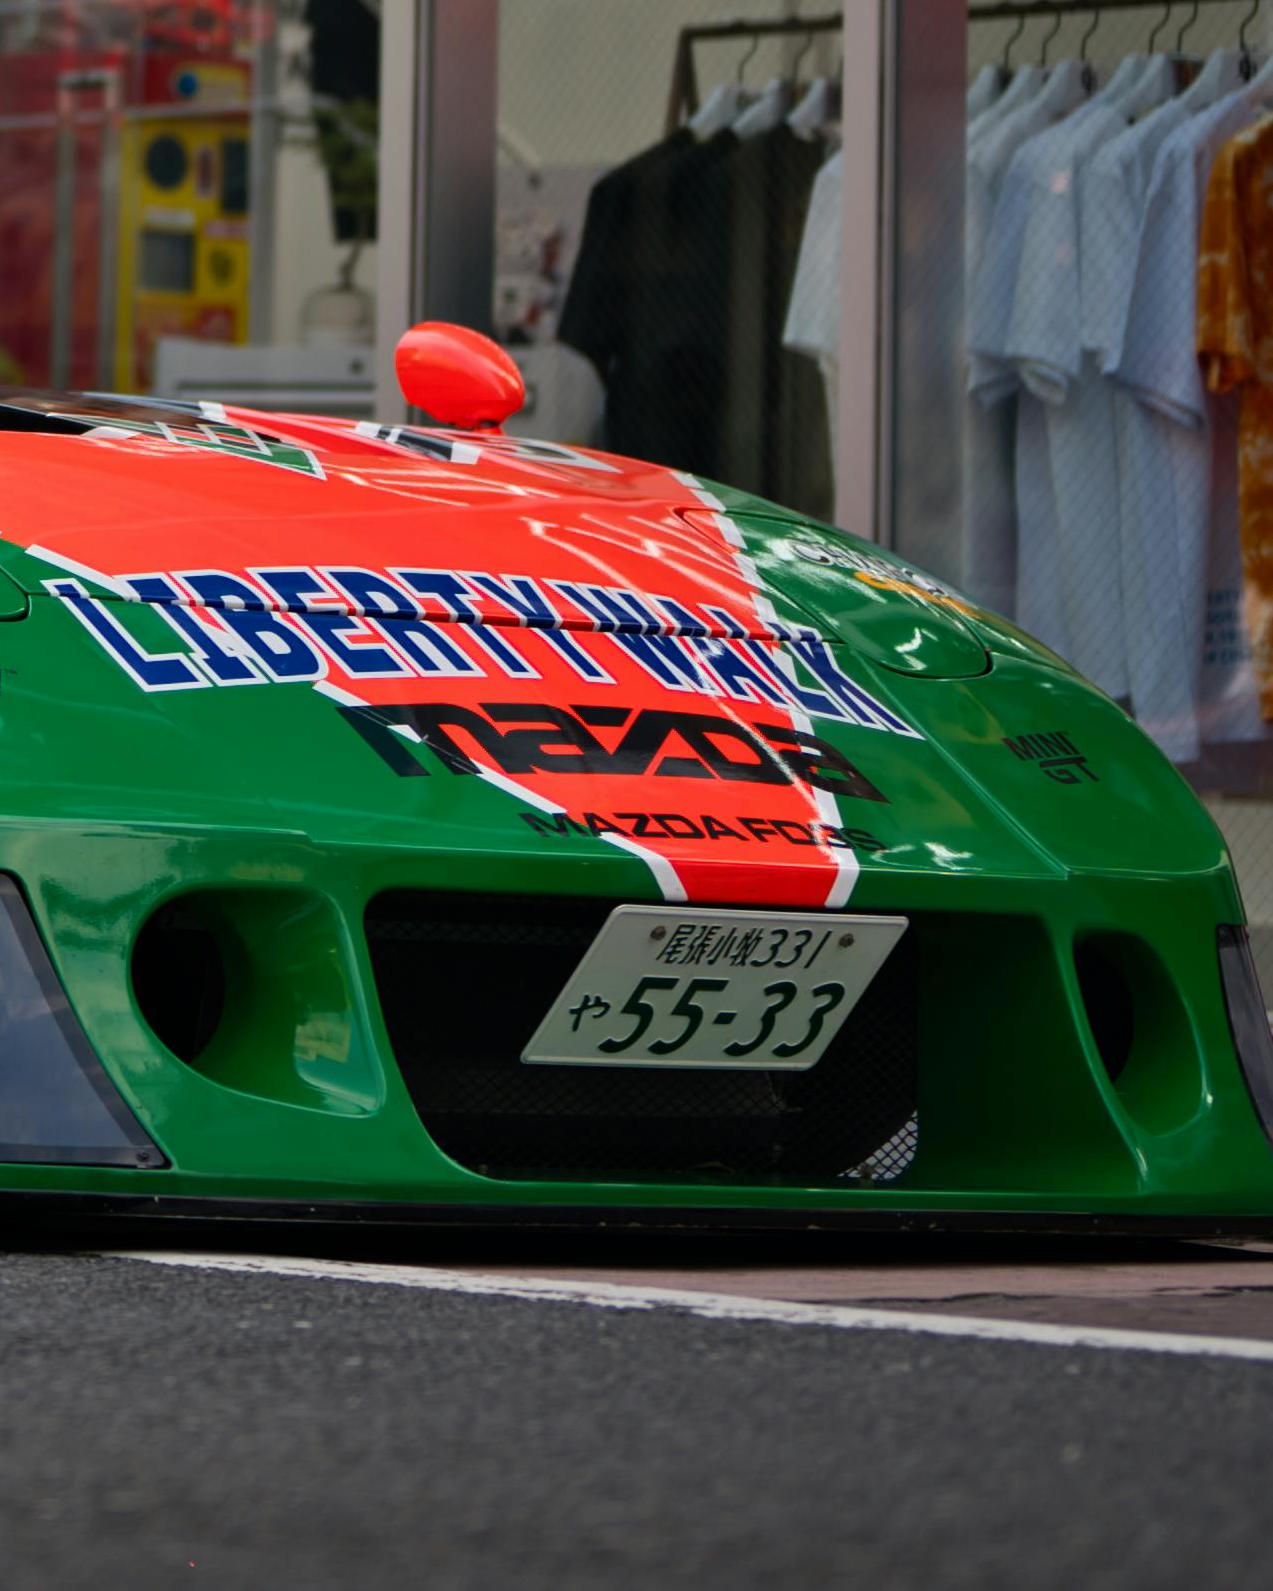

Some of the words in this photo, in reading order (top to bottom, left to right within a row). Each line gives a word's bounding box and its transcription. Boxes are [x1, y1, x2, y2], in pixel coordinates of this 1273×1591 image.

[39, 567, 618, 694] LIBERTY
[578, 583, 926, 741] WALK
[518, 811, 752, 843] MAZDA
[568, 992, 612, 1033] や
[596, 975, 846, 1058] 55-33
